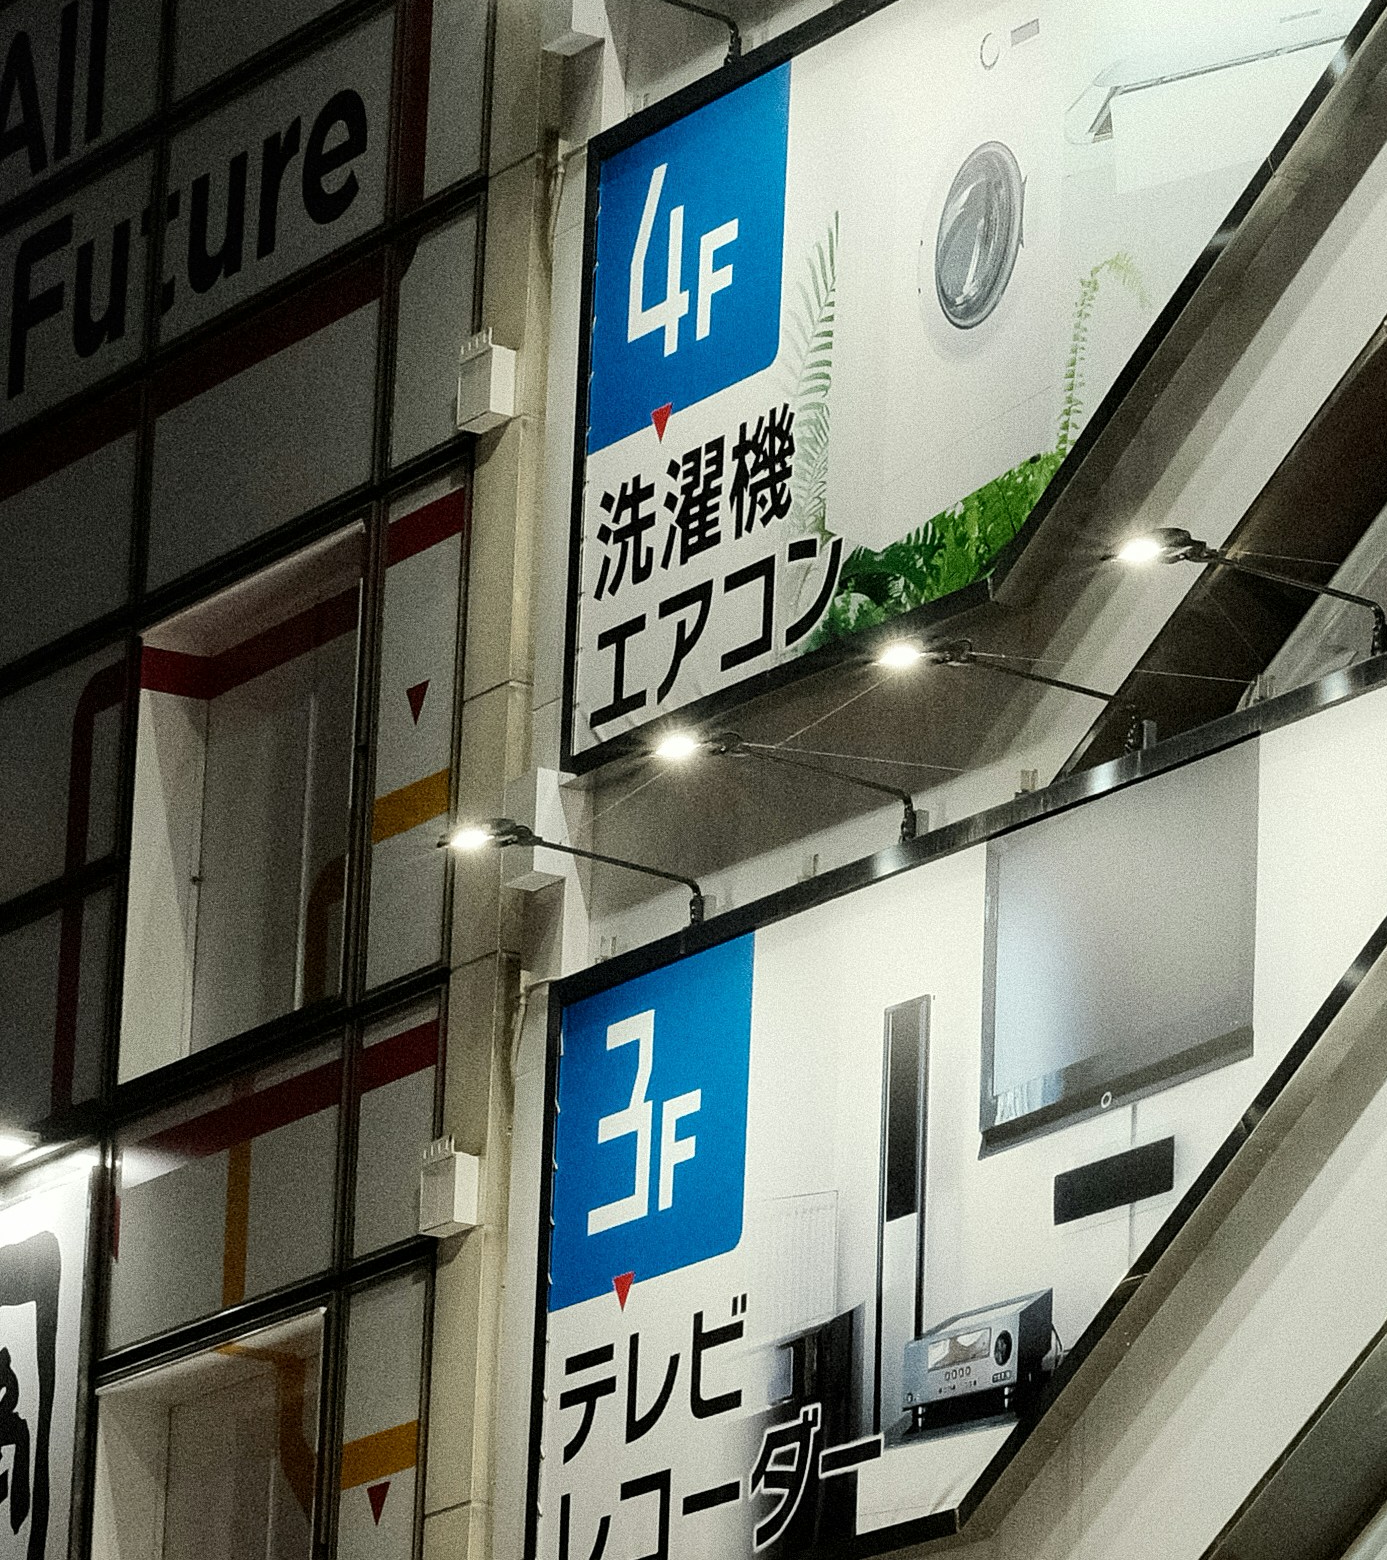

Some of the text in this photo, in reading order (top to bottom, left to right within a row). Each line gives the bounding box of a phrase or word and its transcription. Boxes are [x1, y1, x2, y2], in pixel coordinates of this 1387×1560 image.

[627, 163, 740, 358] 4F
[595, 402, 796, 603] 洗濯機
[590, 537, 844, 729] エアコン
[588, 1010, 702, 1236] 3F
[559, 1295, 748, 1465] テレビ
